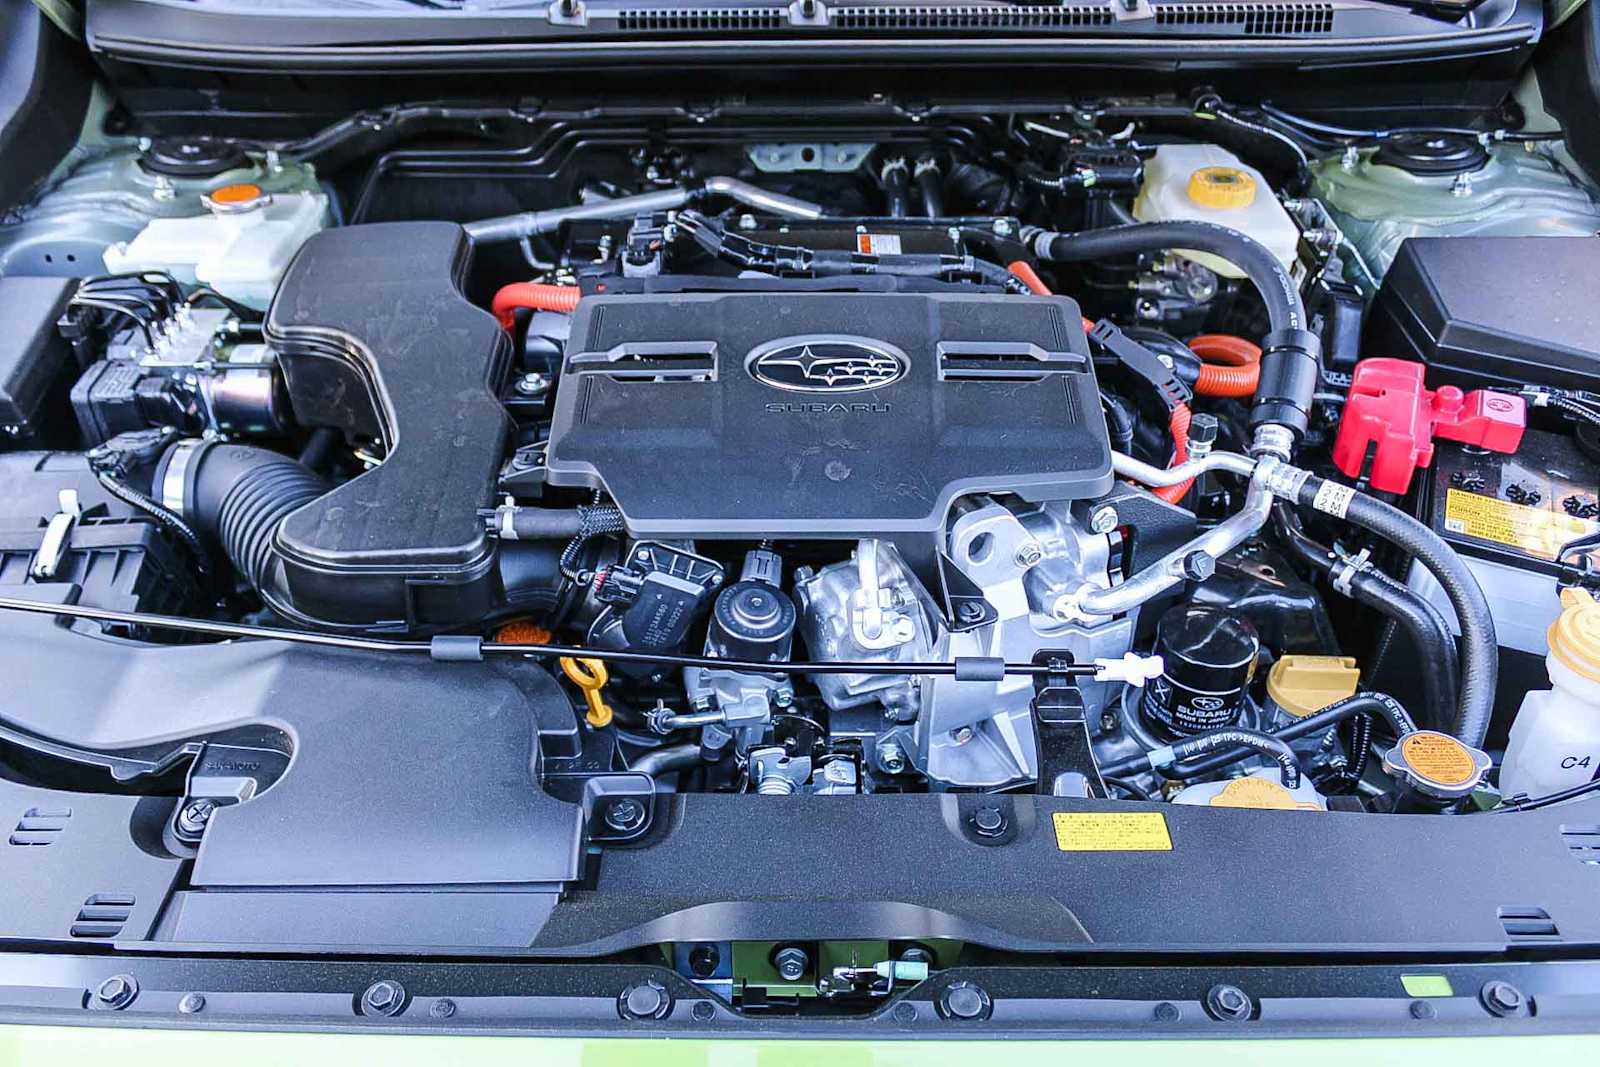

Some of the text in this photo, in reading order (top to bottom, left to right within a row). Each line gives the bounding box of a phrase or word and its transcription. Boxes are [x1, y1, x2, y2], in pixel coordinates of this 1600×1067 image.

[764, 402, 892, 413] SUBARU
[1177, 704, 1232, 718] SUBARU
[1175, 712, 1197, 723] MADE
[1561, 755, 1591, 769] C4
